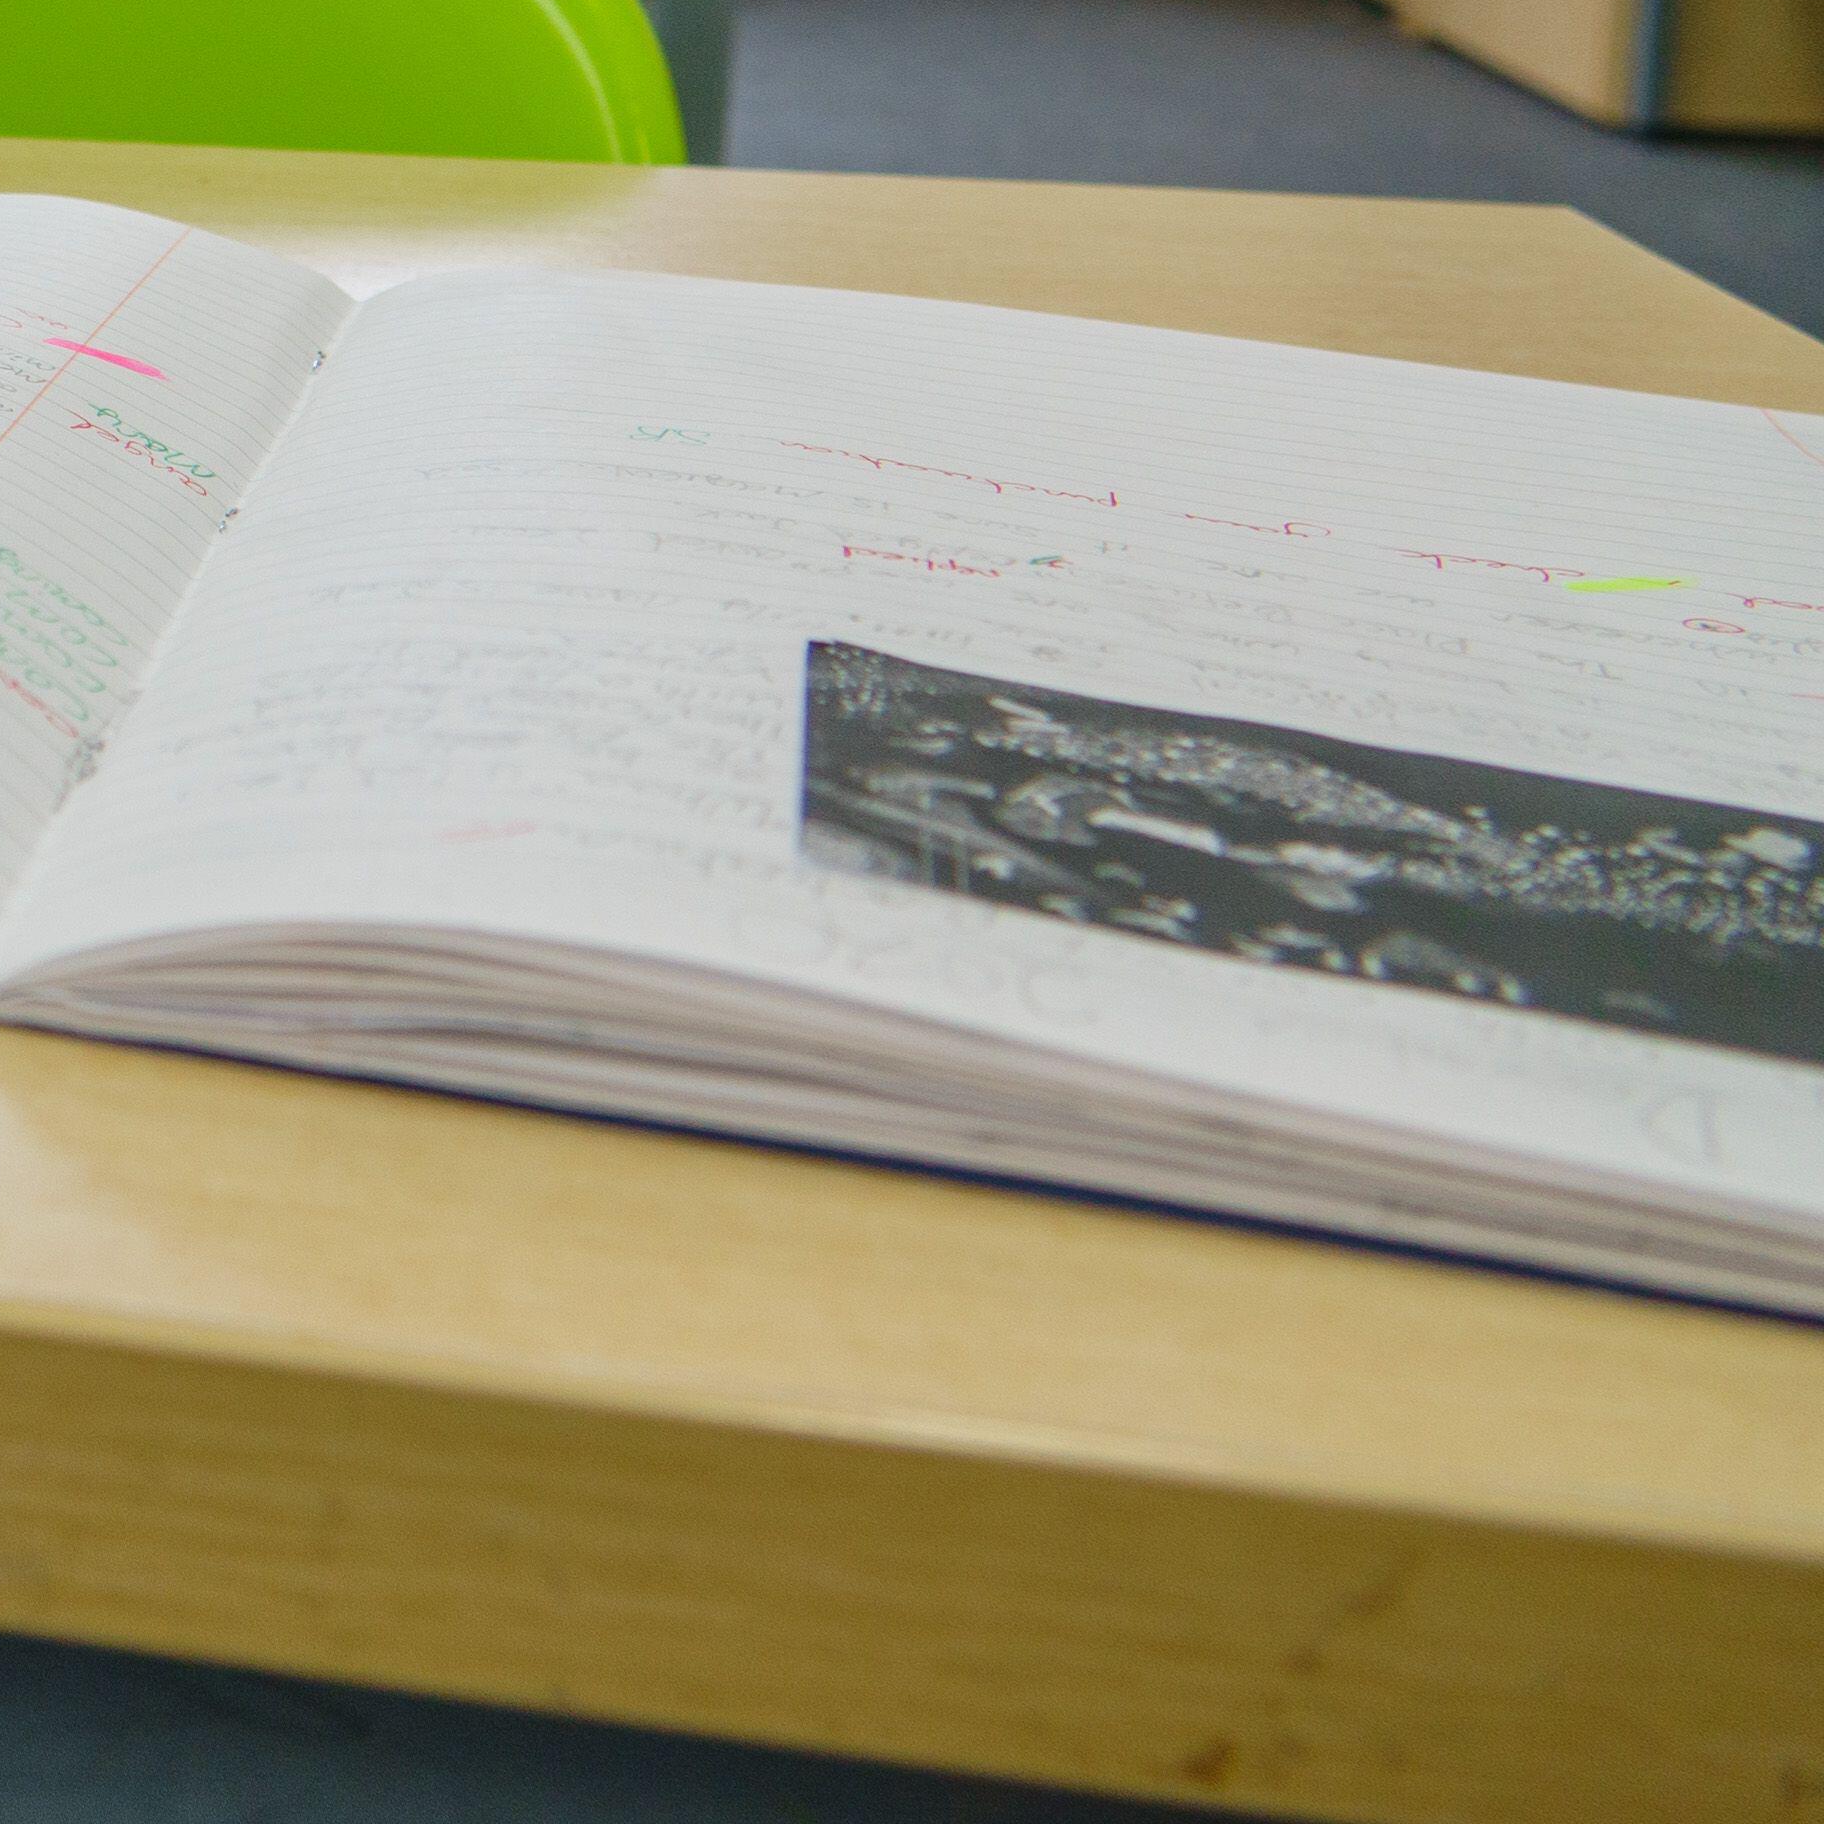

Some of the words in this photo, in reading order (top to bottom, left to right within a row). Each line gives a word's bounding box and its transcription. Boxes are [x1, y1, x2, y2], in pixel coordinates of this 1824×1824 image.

[65, 407, 209, 498] angel
[87, 403, 219, 479] Mary
[844, 545, 1002, 577] replied
[1394, 548, 1585, 583] check
